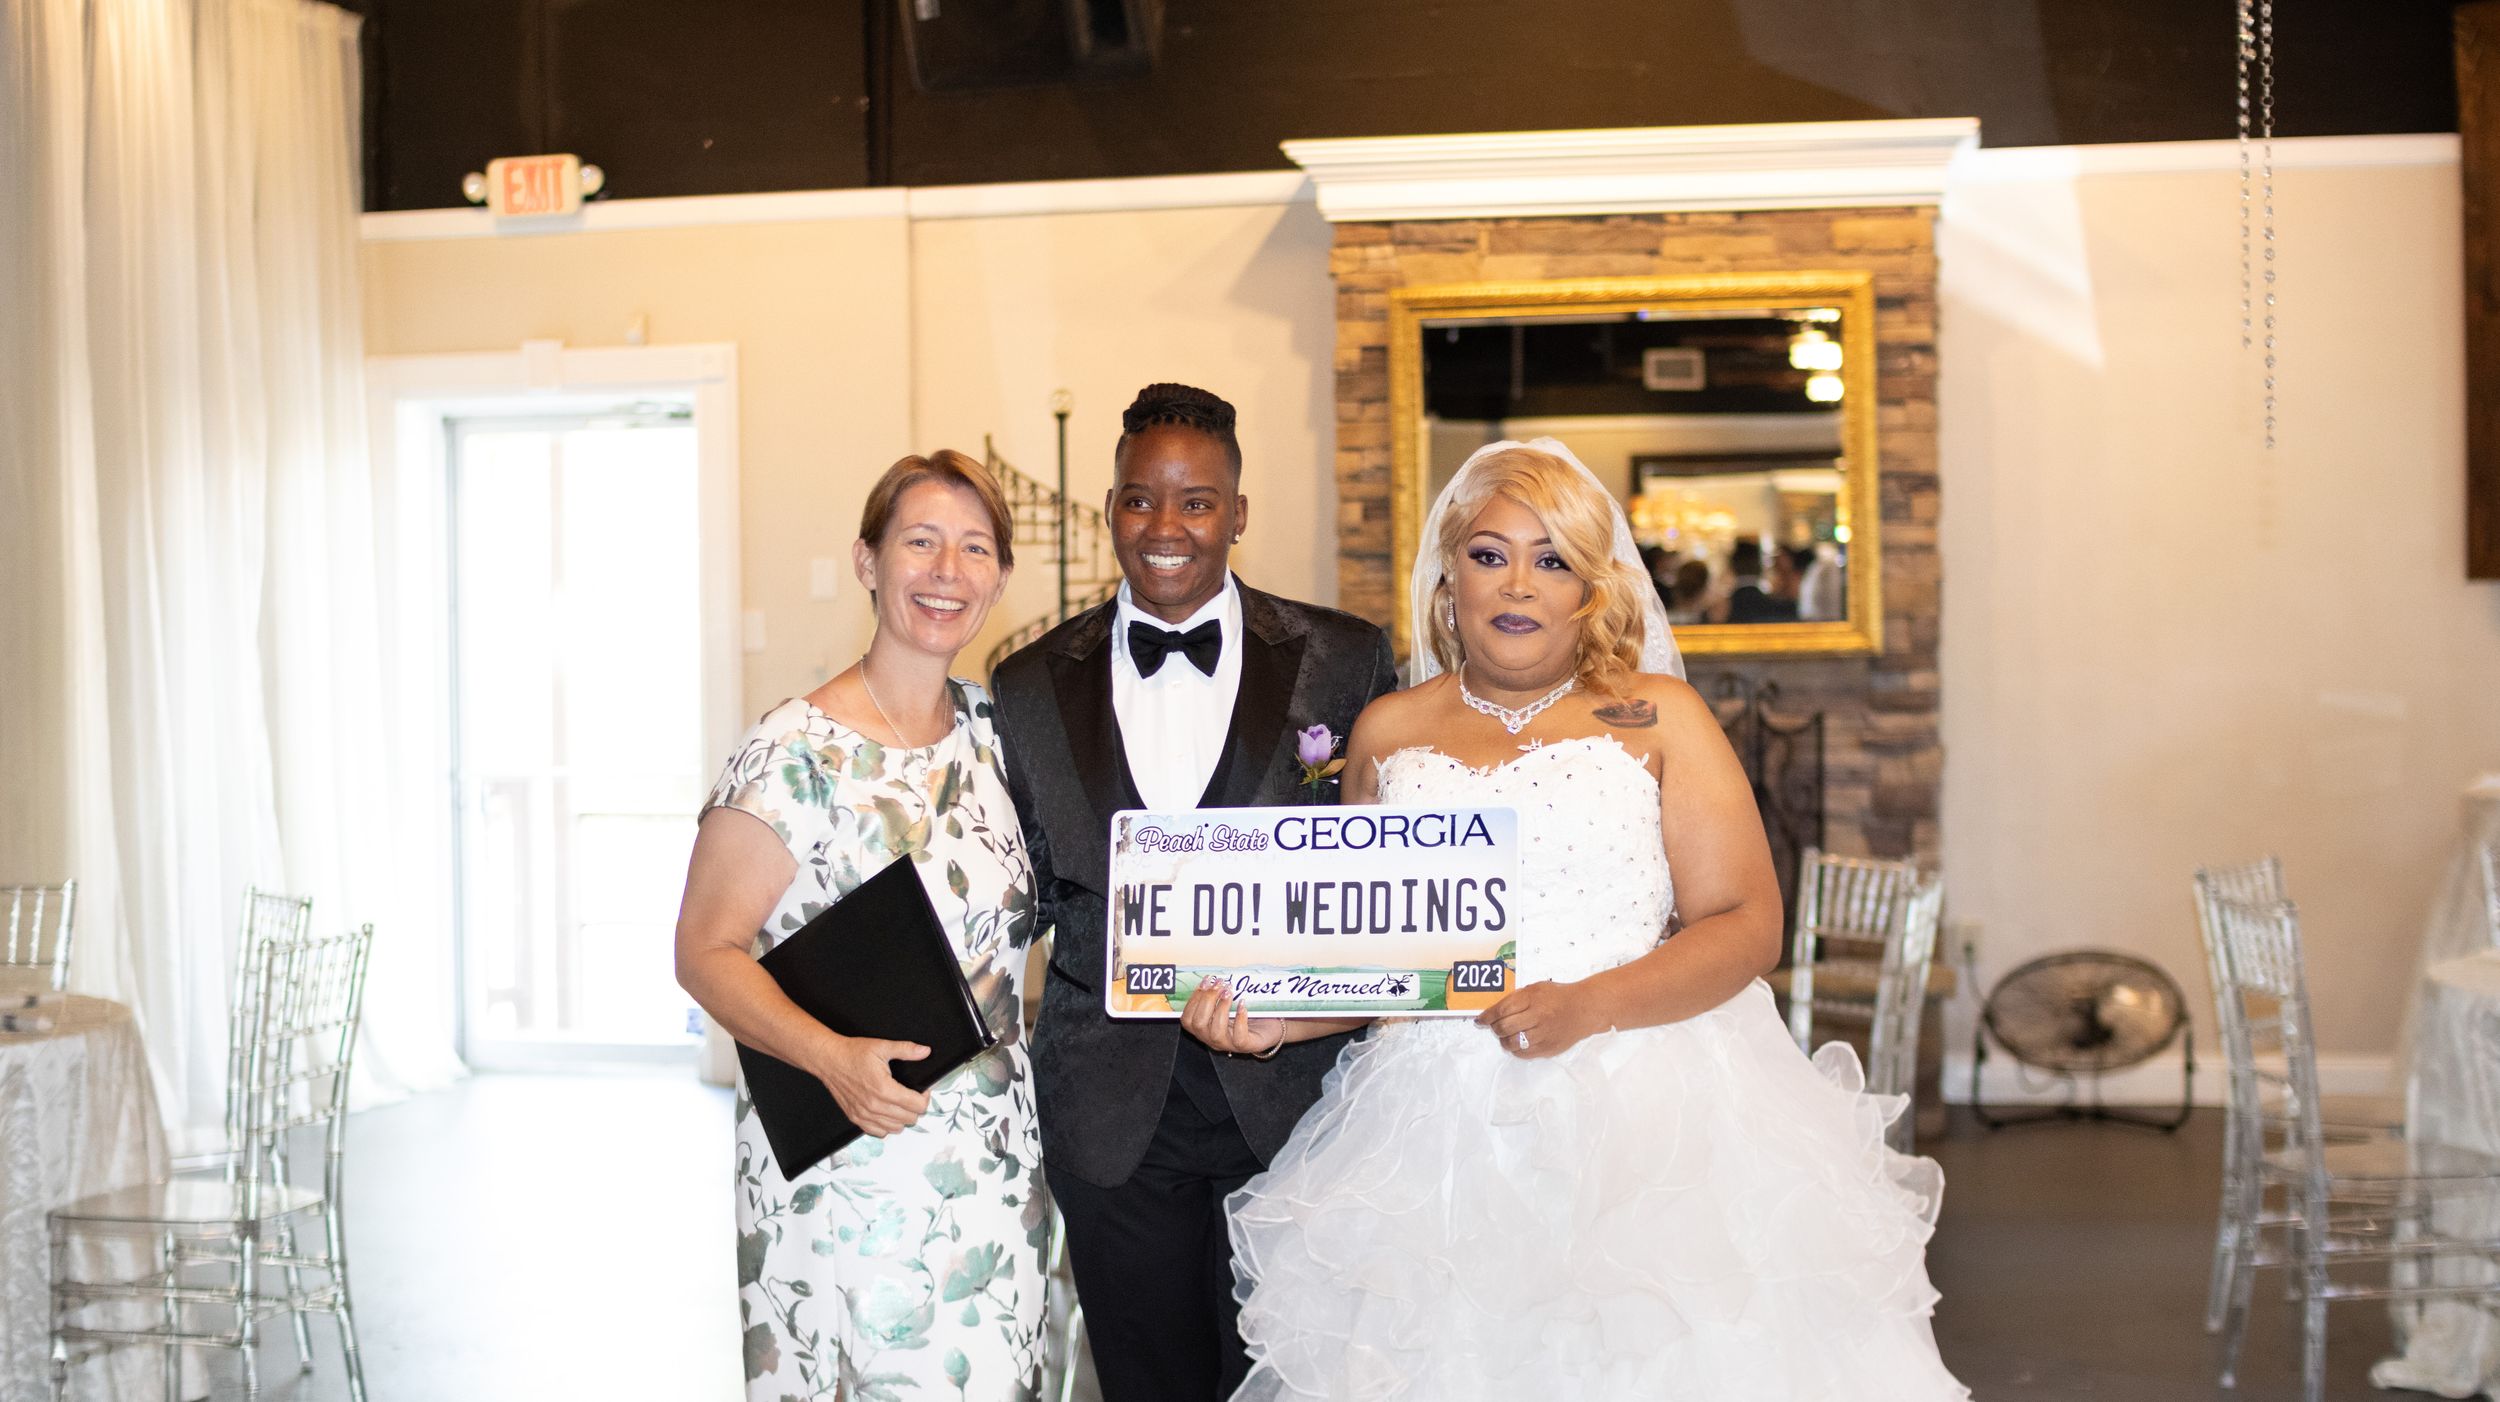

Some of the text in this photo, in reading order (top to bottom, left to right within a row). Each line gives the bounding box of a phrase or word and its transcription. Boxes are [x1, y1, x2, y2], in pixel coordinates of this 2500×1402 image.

[503, 158, 566, 214] EXIT
[1135, 813, 1496, 854] Peach State GEORGIA
[1123, 877, 1507, 937] WE DO! WEDDINGS
[1130, 967, 1174, 990] 2023
[1232, 975, 1386, 1001] Just Married
[1457, 964, 1503, 987] 2023
